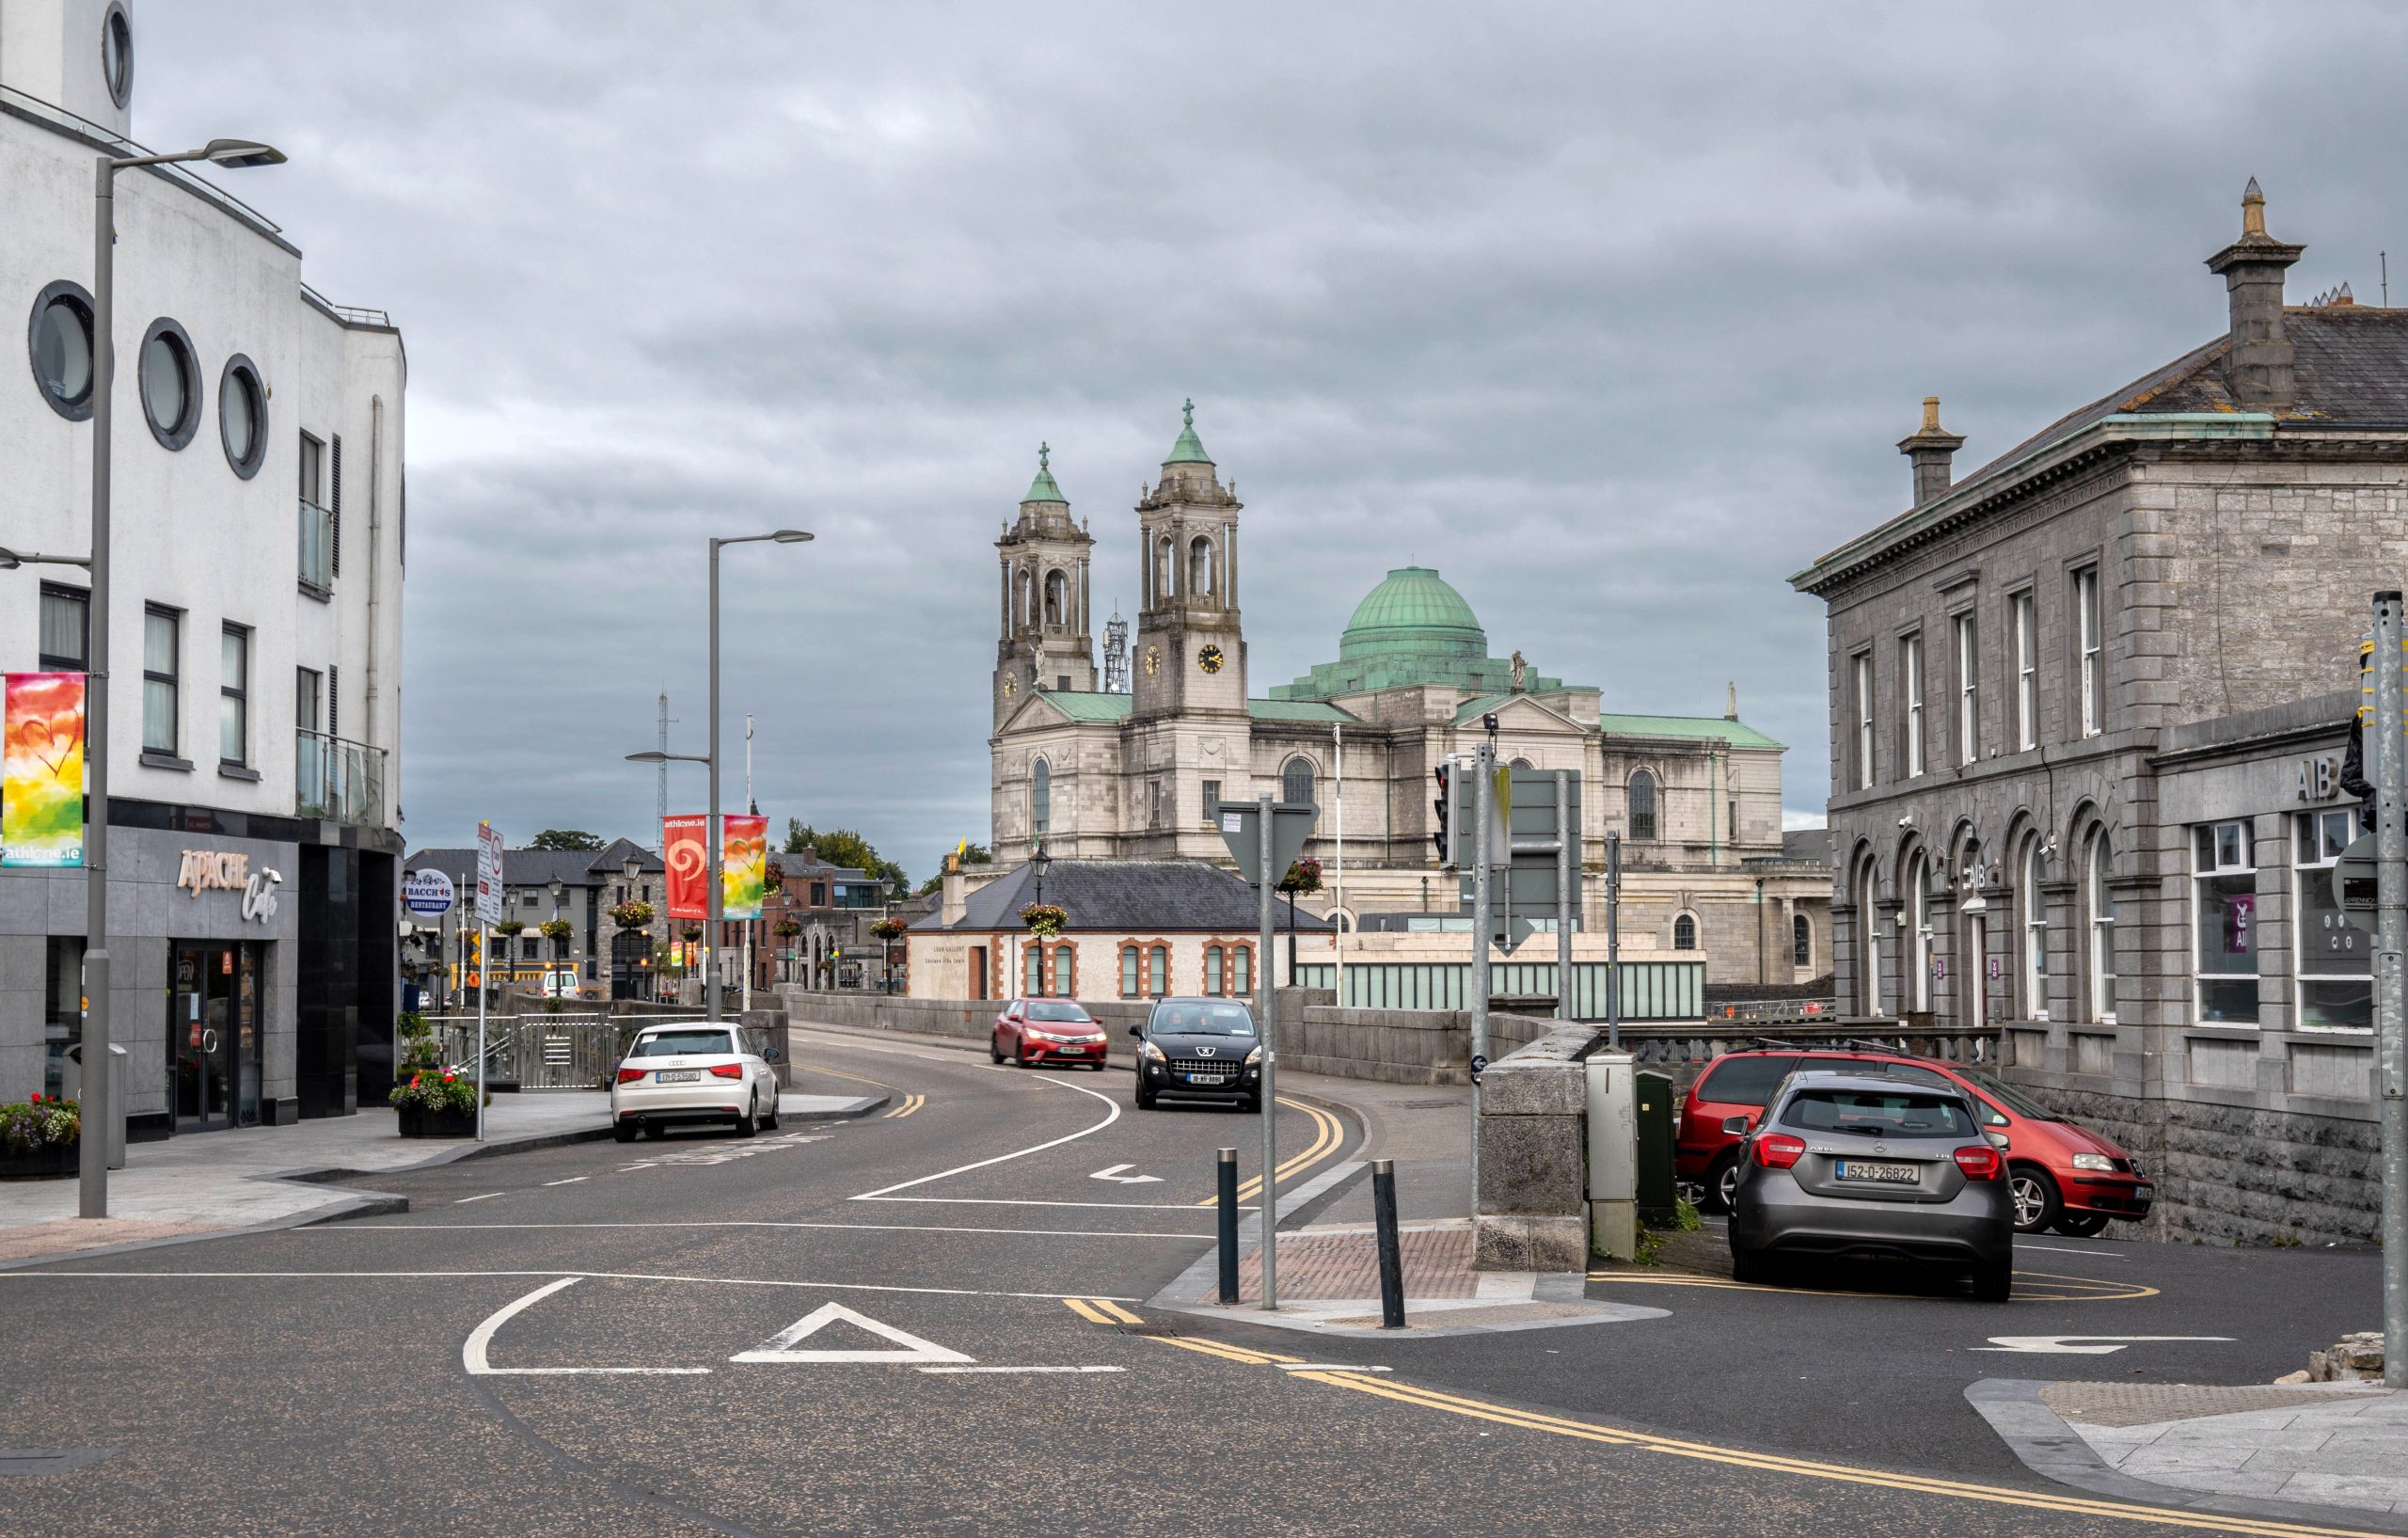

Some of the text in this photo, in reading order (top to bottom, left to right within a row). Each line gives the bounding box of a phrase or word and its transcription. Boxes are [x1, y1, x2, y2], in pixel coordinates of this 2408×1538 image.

[2297, 756, 2335, 800] AIB
[664, 819, 705, 828] athlone.ie
[6, 847, 80, 860] athlone.ie
[178, 850, 248, 897] APACHE
[1970, 864, 1986, 888] AIB
[410, 901, 447, 910] RESTAURANT
[2237, 930, 2246, 946] AI
[1846, 1165, 1914, 1181] 152-D-26822
